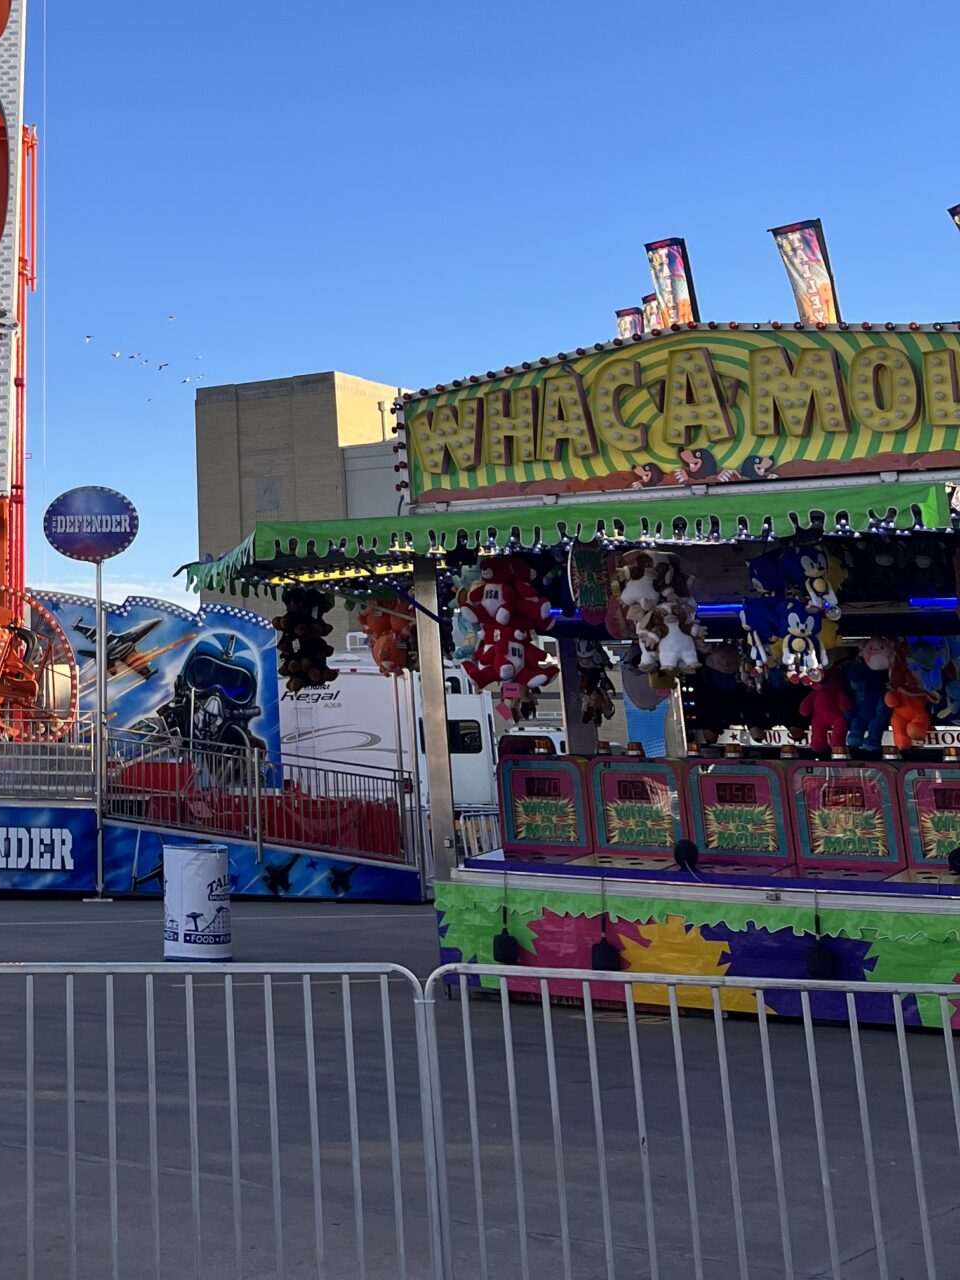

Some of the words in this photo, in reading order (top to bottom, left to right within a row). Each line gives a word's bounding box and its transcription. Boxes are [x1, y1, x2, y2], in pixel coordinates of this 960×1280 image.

[410, 360, 648, 474] WHAC
[661, 346, 735, 446] A
[57, 514, 131, 533] DEFENDER
[521, 800, 570, 817] WHAC
[711, 807, 769, 825] WHAC
[525, 824, 572, 839] MOLE
[617, 828, 669, 843] MOLE
[716, 832, 771, 849] MOLE
[823, 835, 880, 853] MOLE
[191, 934, 215, 944] FOOD
